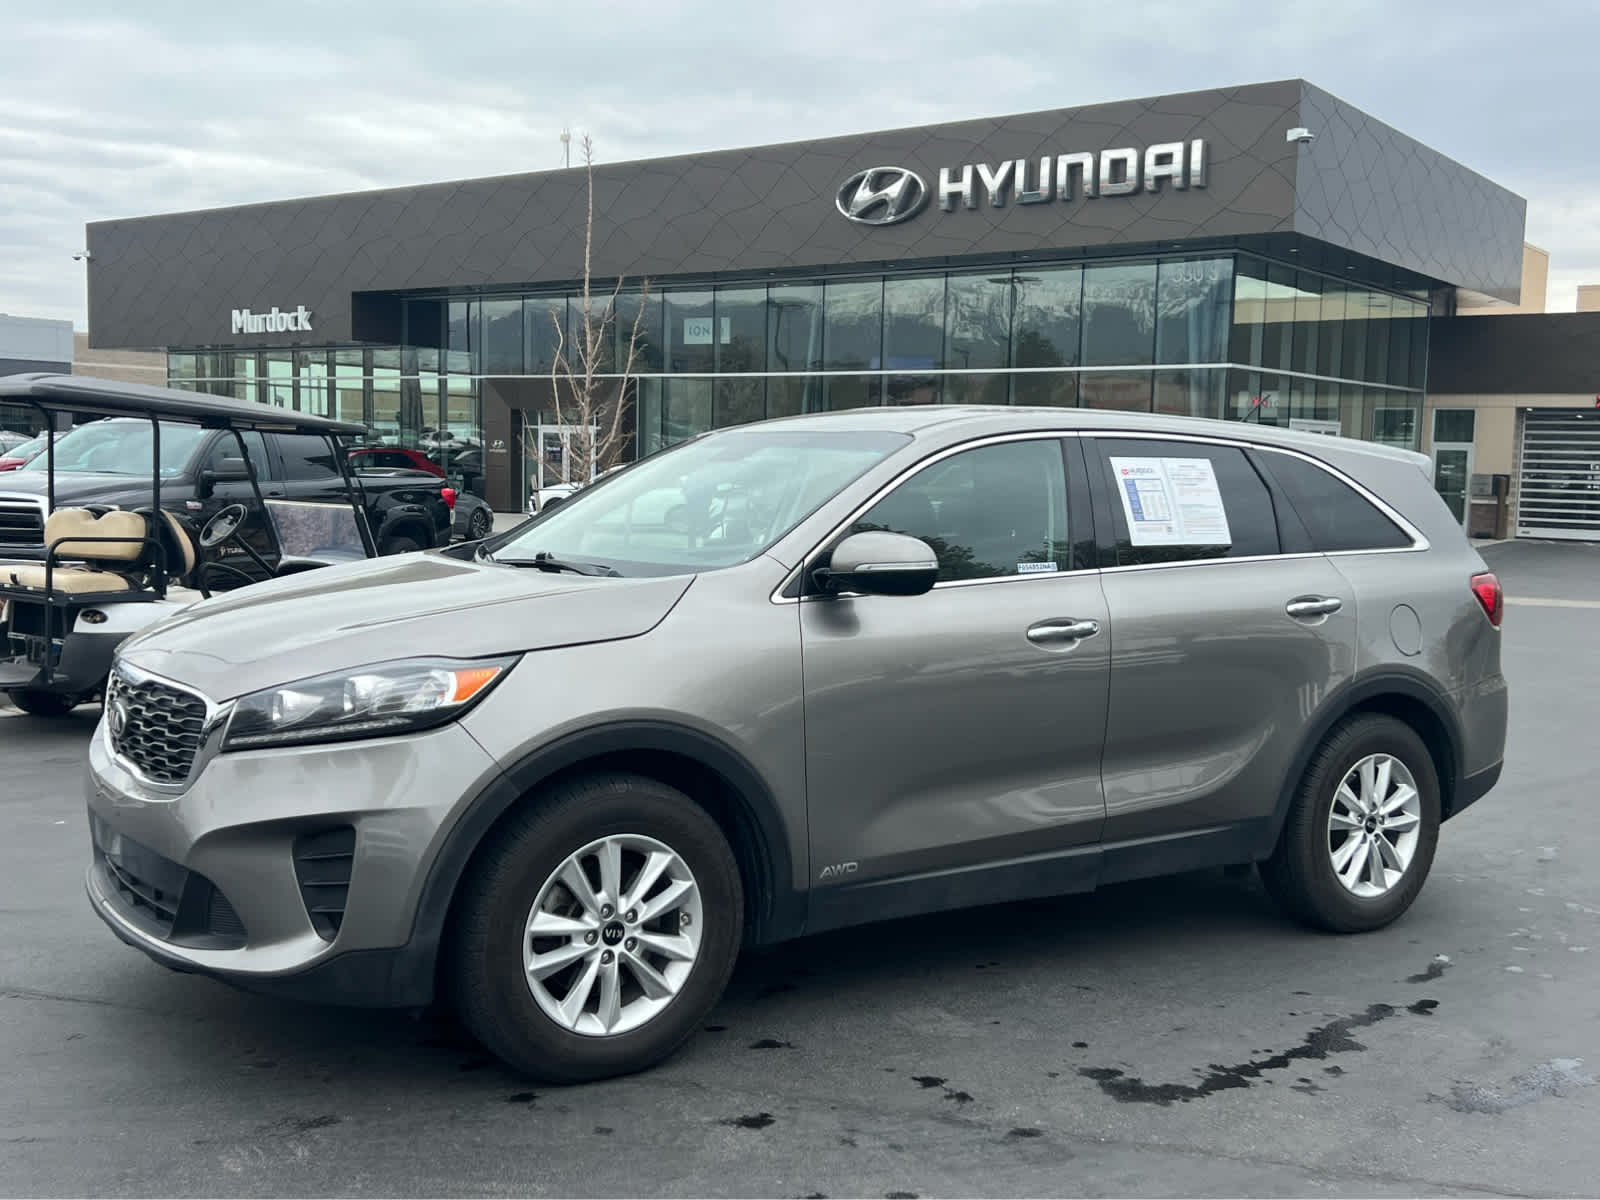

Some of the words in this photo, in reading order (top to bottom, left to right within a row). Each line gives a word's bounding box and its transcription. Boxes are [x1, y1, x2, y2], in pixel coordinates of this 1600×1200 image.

[938, 138, 1208, 212] HYUNDAI
[231, 305, 313, 334] Murdock
[819, 861, 858, 879] AWD
[605, 928, 623, 938] KIA
